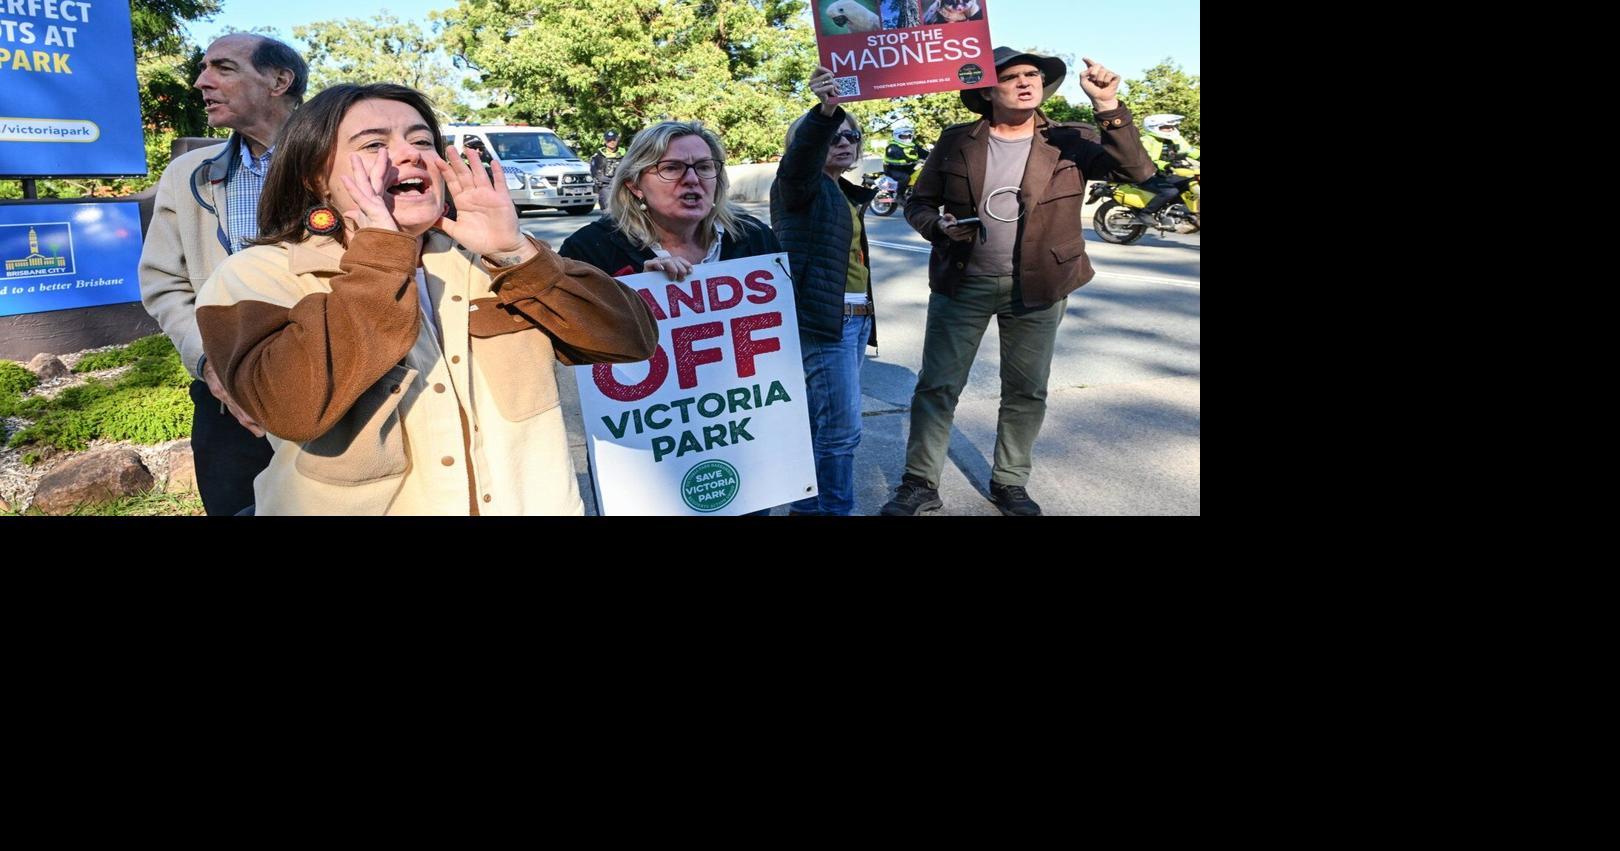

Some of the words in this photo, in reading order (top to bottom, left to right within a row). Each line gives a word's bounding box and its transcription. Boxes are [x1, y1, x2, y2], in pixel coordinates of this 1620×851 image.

[0, 19, 36, 44] TS
[44, 25, 77, 48] AT
[867, 33, 909, 47] STOP
[911, 28, 943, 42] THE
[0, 47, 72, 74] PARK
[830, 37, 981, 73] MADNESS
[6, 268, 47, 277] BRISBANE
[12, 286, 24, 295] to
[39, 282, 72, 292] better
[75, 278, 124, 289] Brisbane
[592, 311, 783, 402] OFF
[600, 380, 792, 440] VICTORIA
[651, 417, 755, 463] PARK
[685, 477, 736, 495] VICTORIA
[695, 470, 723, 483] SAVE
[698, 488, 726, 503] PARK
